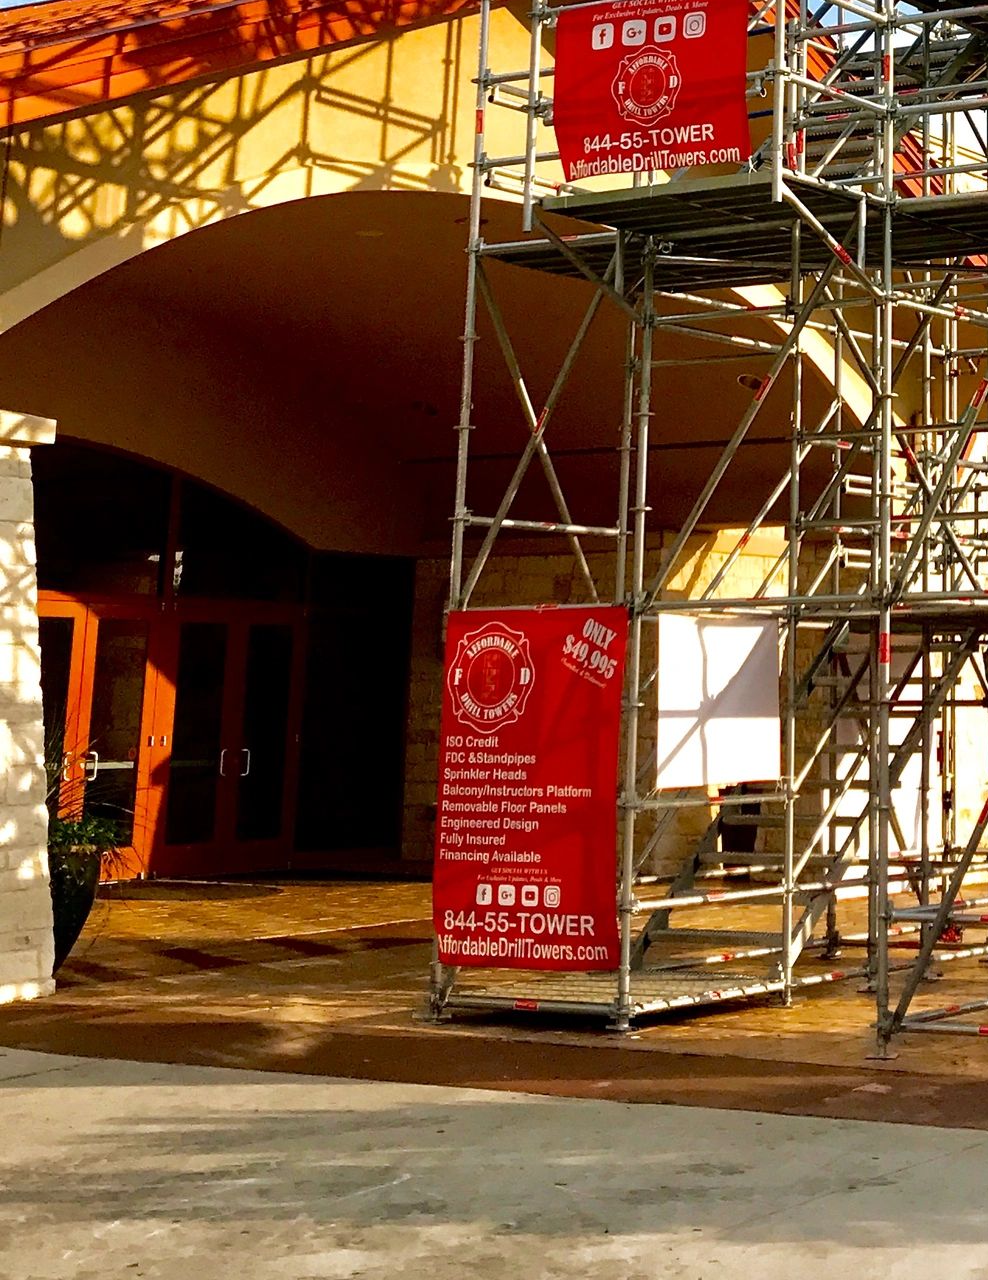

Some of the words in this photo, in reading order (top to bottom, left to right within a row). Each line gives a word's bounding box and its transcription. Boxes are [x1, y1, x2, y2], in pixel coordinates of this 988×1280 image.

[628, 55, 668, 75] AFFORDABLE
[624, 99, 642, 116] DRILL
[643, 95, 669, 117] TOWERS
[584, 123, 715, 154] 844-55-TOWER
[569, 147, 740, 180] AffordableDrillTowers.com
[582, 618, 617, 651] ONLY
[466, 636, 520, 660] AFFORDABLE
[562, 634, 618, 680] $49,995
[453, 667, 463, 686] F
[519, 667, 531, 685] D
[460, 692, 481, 719] DRILL
[483, 692, 518, 720] TOWERS
[446, 735, 463, 748] ISO
[466, 735, 499, 748] Credit
[445, 751, 466, 764] FDC
[443, 767, 490, 782] Sprinkler
[493, 768, 527, 781] Heads
[442, 783, 543, 799] Balcony/Instructors
[546, 785, 592, 798] Platform
[441, 800, 498, 813] Removable
[501, 801, 527, 813] Floor
[529, 801, 567, 814] Panels
[440, 816, 500, 831] Engineered
[502, 817, 539, 832] Design
[440, 832, 464, 847] Fully
[466, 833, 506, 846] Insured
[439, 848, 490, 864] Financing
[491, 850, 542, 863] Available
[444, 910, 595, 937] 844-55-TOWER
